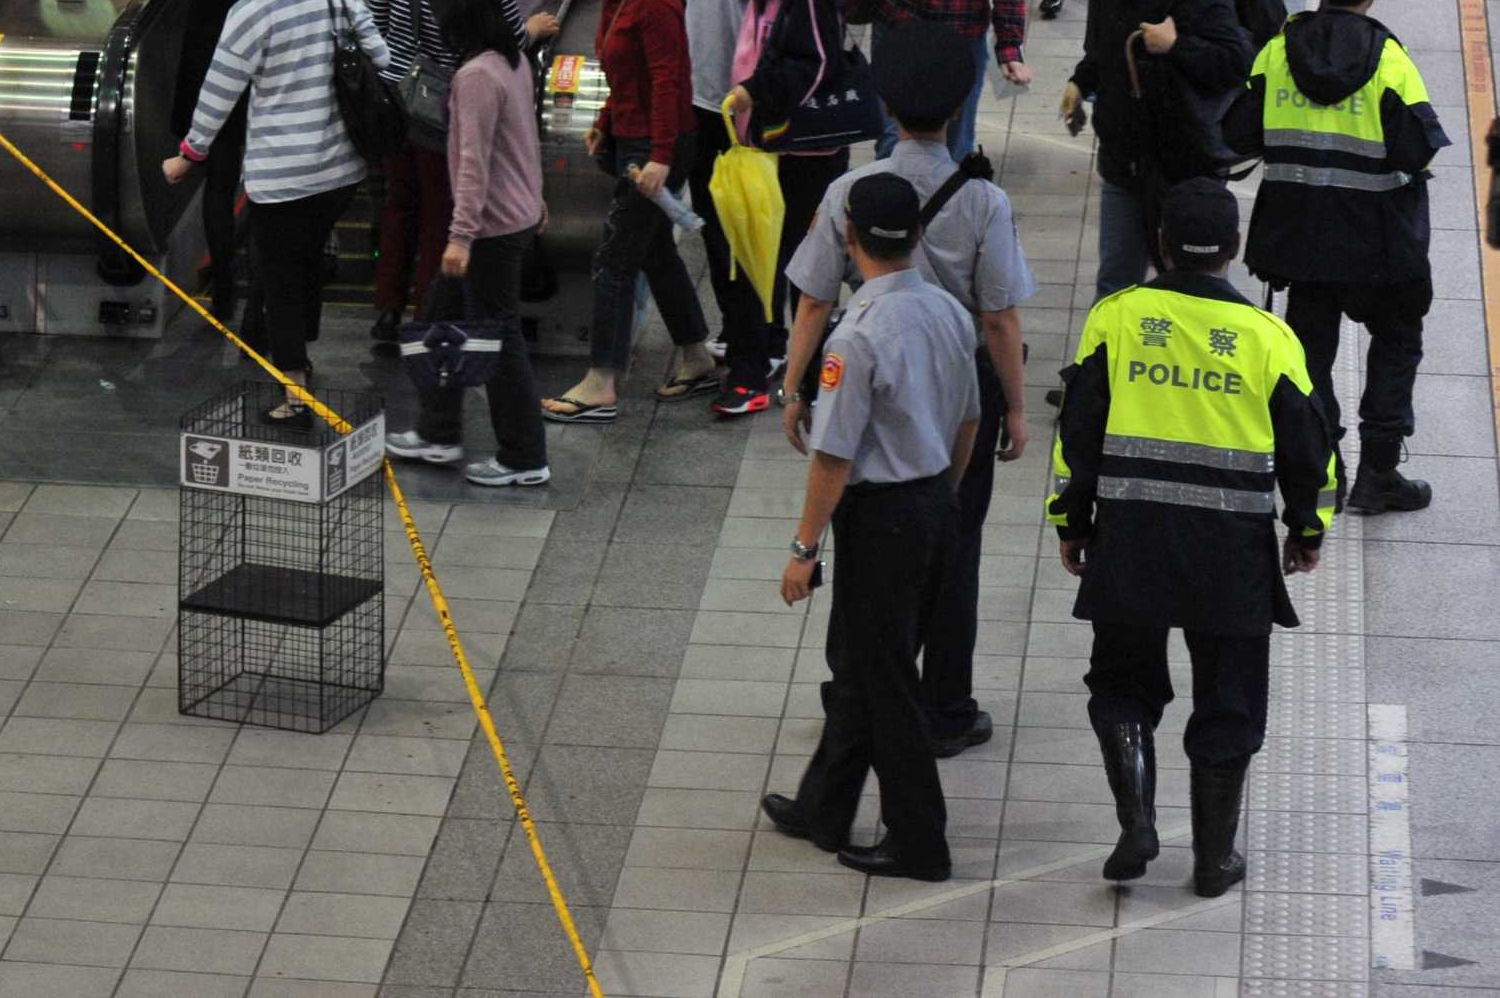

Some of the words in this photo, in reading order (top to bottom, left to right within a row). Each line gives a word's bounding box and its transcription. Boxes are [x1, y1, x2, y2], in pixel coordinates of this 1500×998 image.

[1139, 317, 1173, 348] 警
[1209, 328, 1238, 357] 察
[1128, 360, 1243, 395] POLICE
[238, 444, 302, 467] 紙類回收
[237, 473, 263, 483] Paper
[266, 476, 309, 491] Recycling
[1371, 850, 1404, 891] Waiting
[1379, 895, 1400, 921] Line
